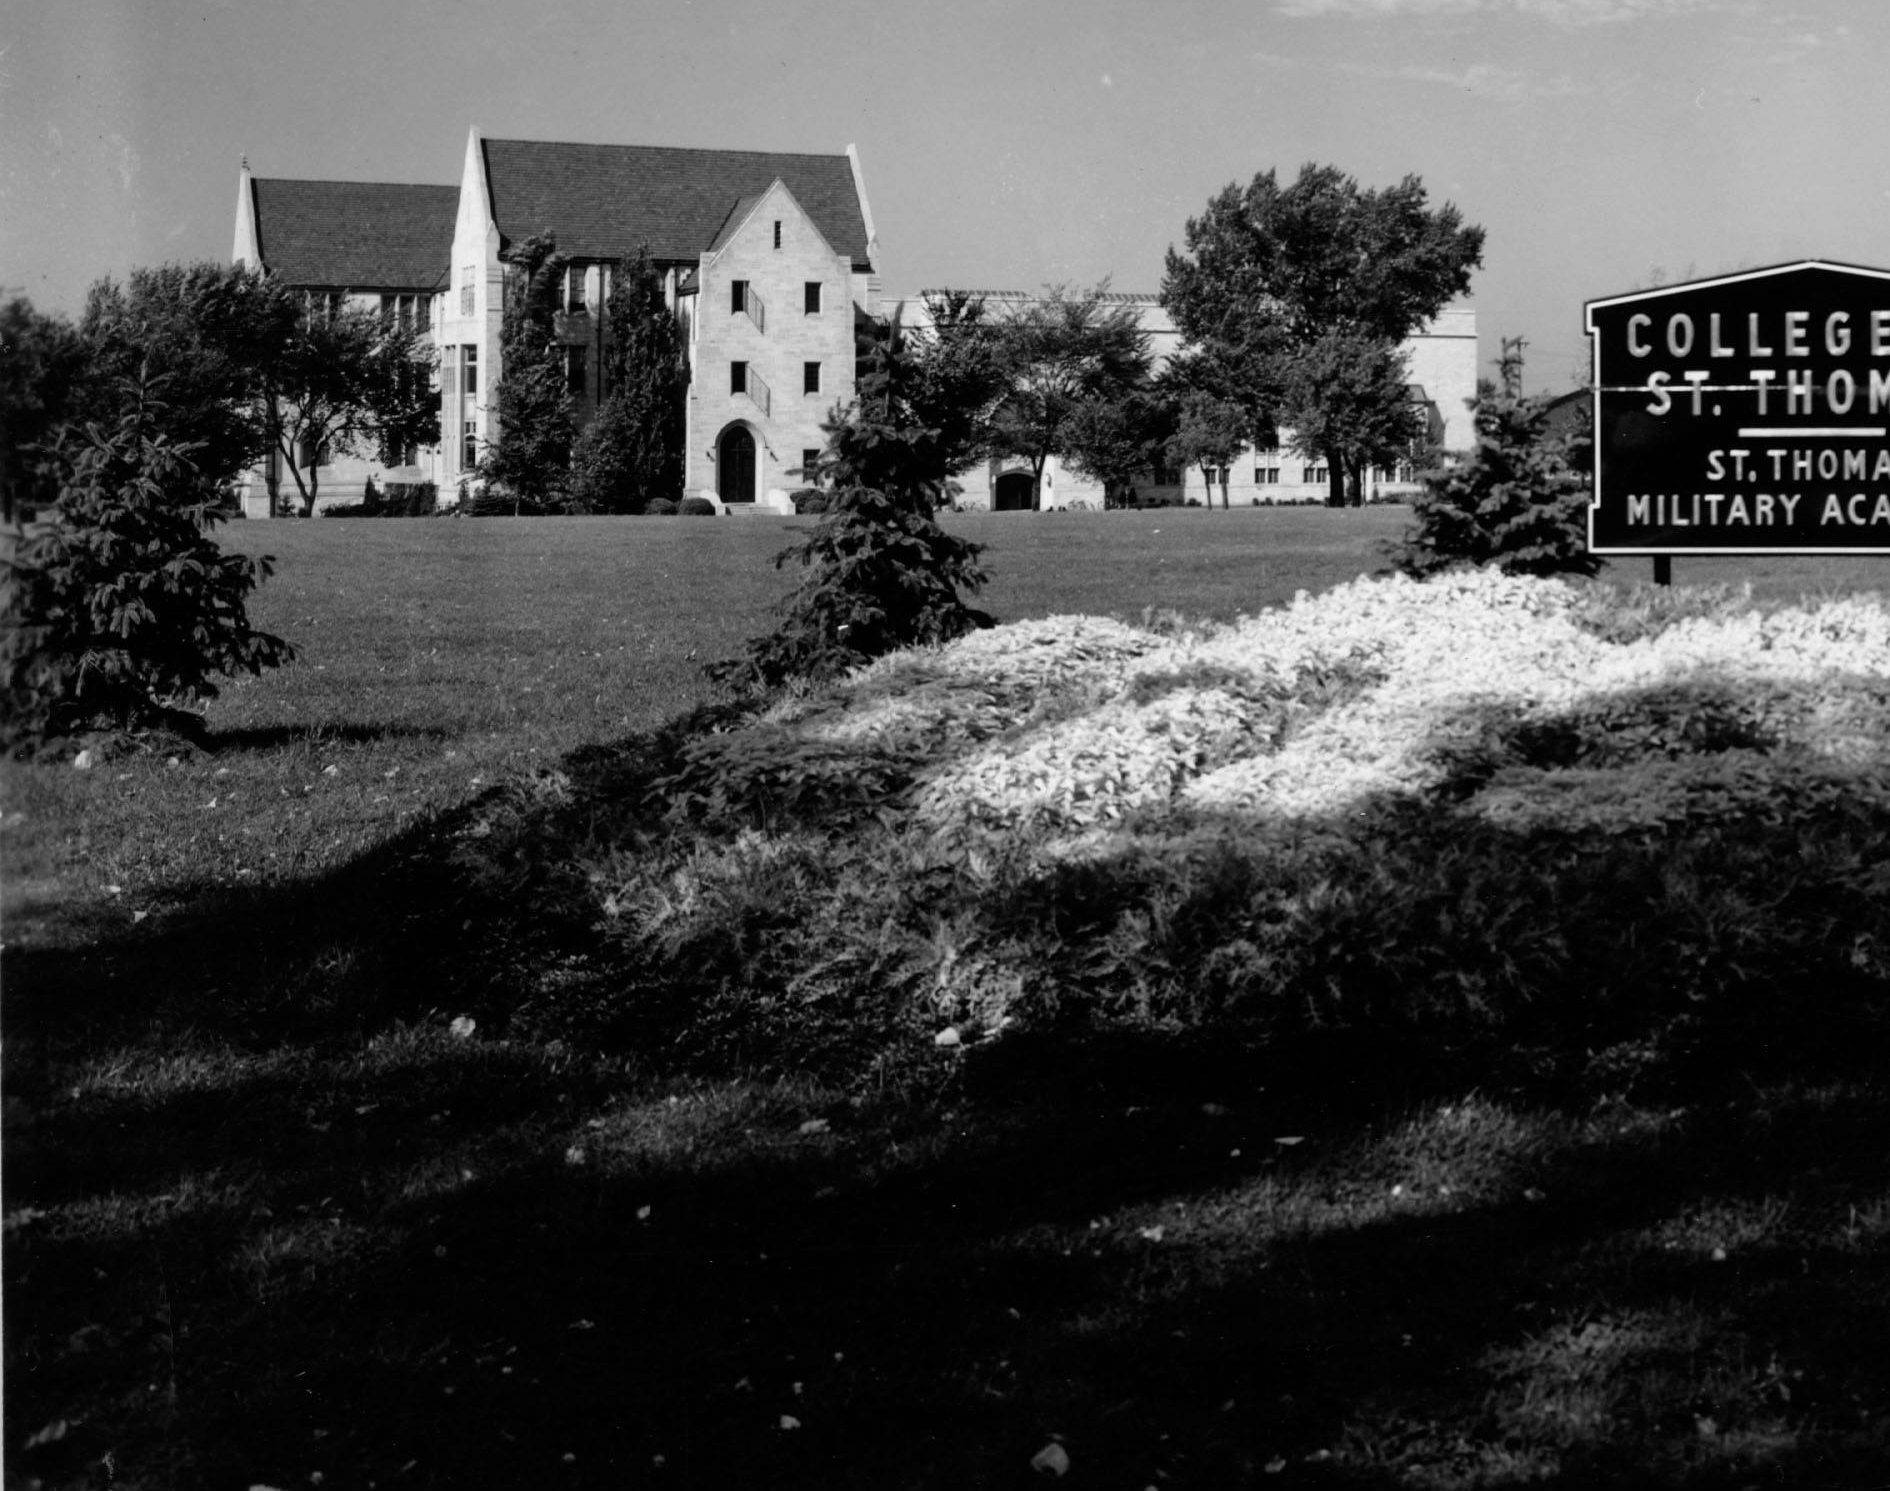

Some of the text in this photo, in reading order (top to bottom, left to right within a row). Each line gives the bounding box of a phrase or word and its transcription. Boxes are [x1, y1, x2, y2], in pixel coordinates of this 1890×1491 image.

[1646, 370, 1722, 416] ST.
[1706, 449, 1757, 483] ST.
[1627, 494, 1801, 527] MILITARY
